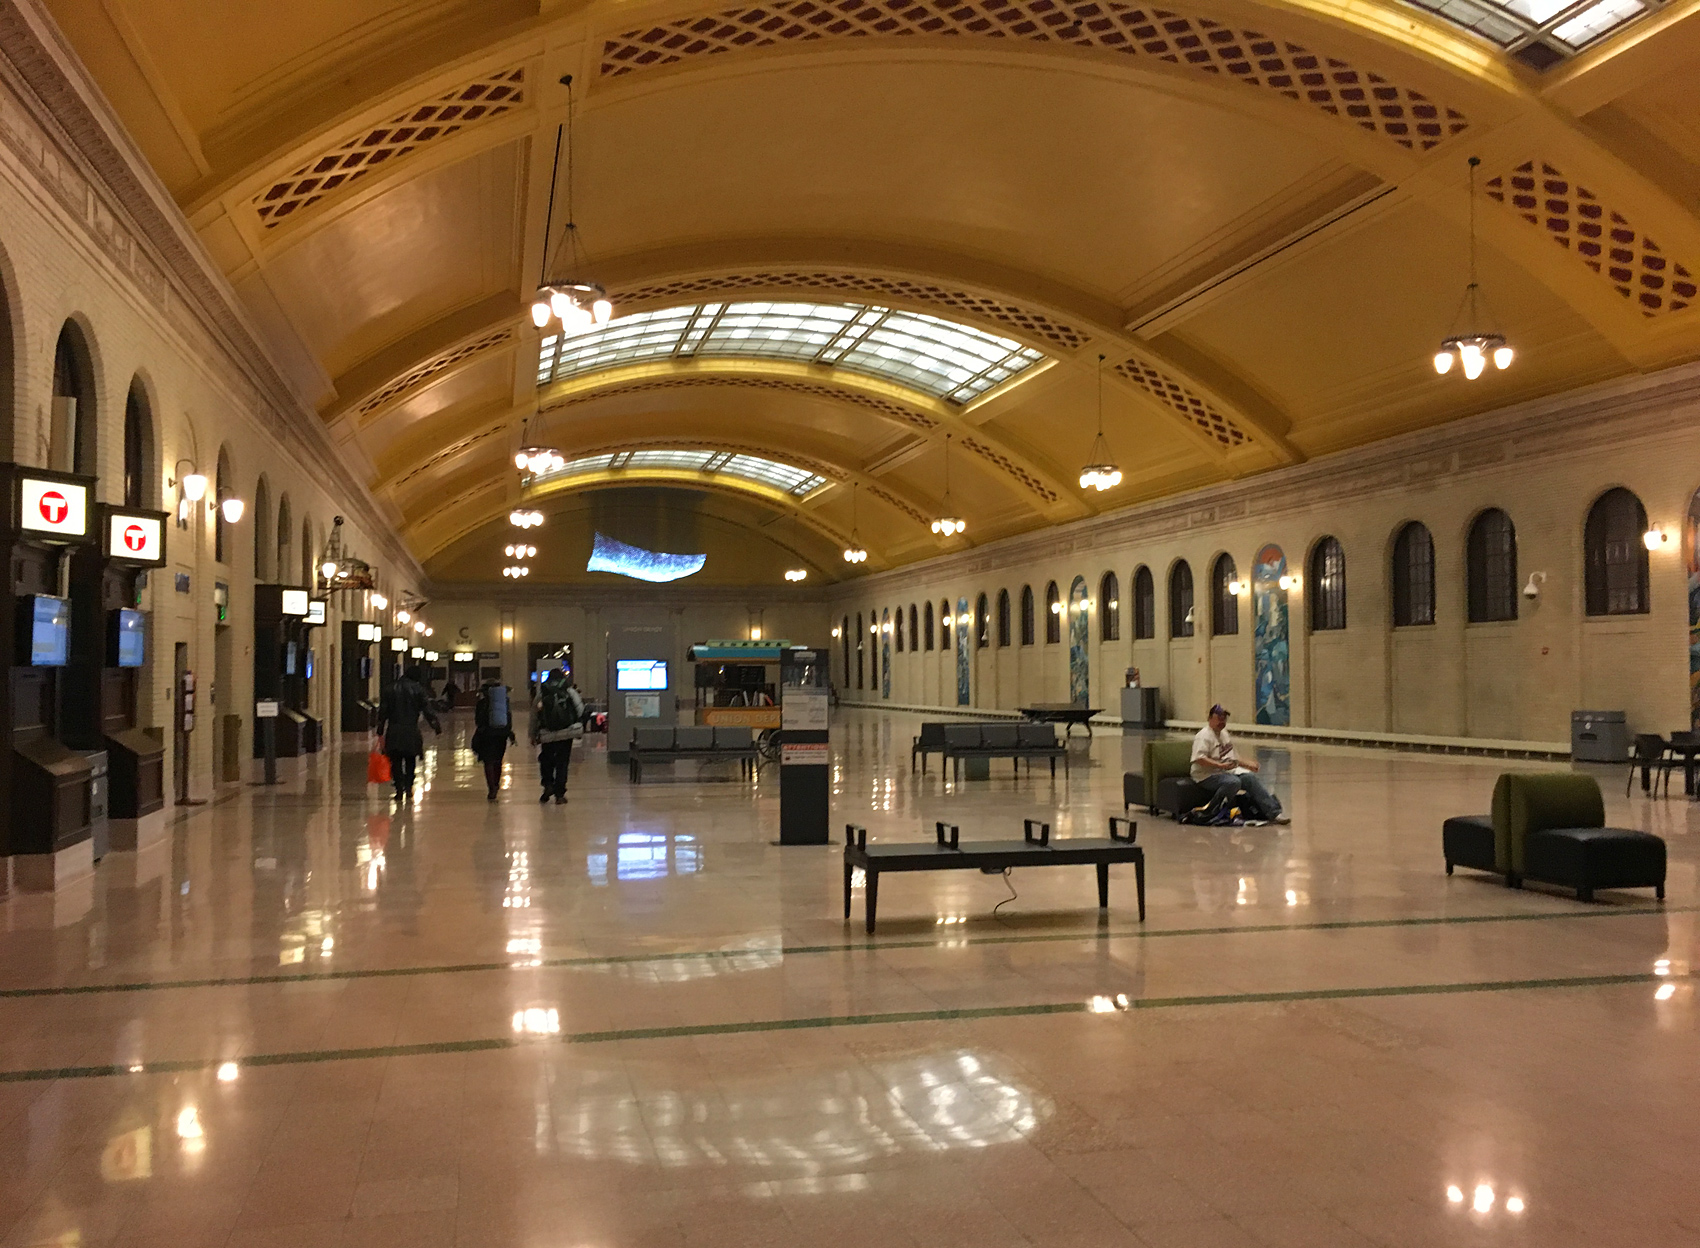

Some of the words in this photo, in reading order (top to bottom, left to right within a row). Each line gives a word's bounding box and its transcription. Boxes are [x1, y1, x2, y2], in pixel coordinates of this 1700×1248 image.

[42, 497, 66, 522] T
[126, 529, 145, 549] T
[459, 627, 469, 639] C
[711, 714, 750, 724] UNION
